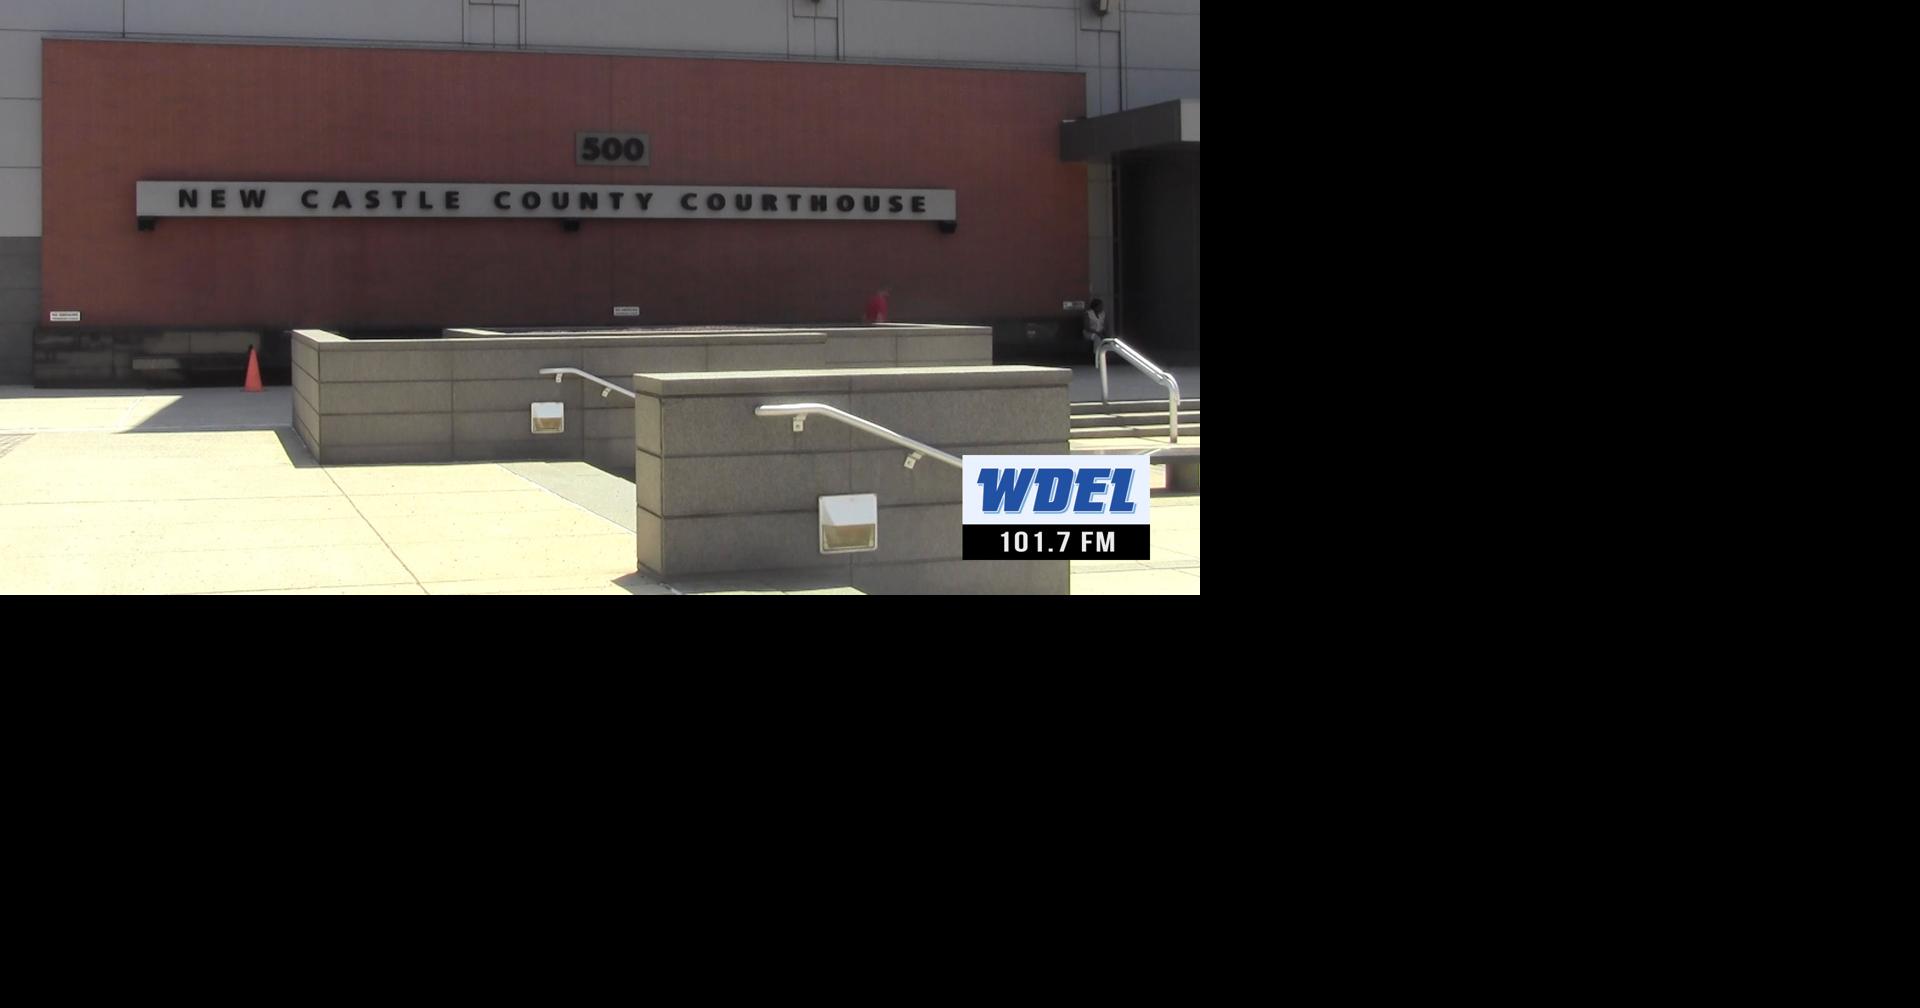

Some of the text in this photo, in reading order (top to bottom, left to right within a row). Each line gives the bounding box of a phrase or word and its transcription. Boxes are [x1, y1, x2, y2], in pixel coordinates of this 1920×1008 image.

[581, 136, 645, 162] 500
[178, 188, 926, 213] NEW CASTLE COUNTY COURTHOUSE
